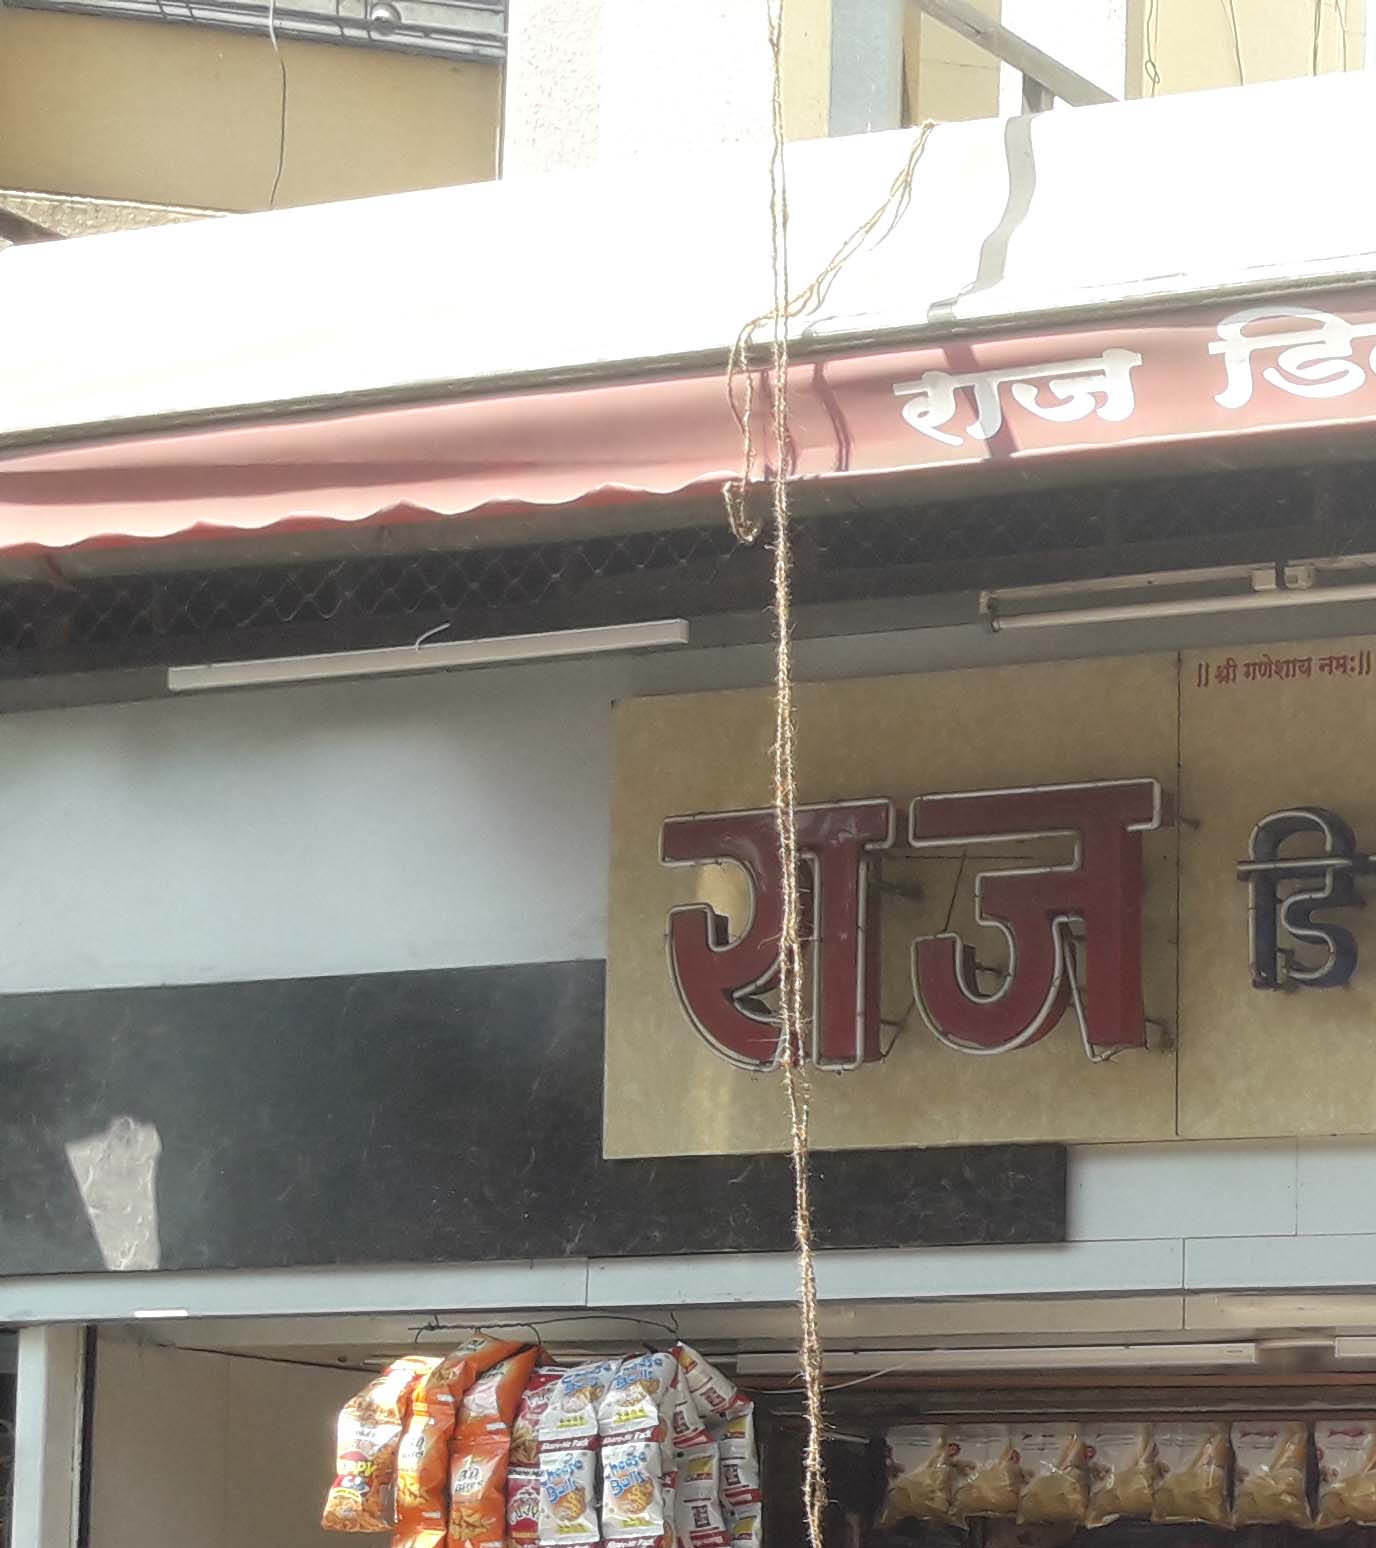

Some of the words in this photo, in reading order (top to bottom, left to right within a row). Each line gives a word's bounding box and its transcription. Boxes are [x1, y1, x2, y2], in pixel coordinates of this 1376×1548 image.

[893, 347, 1143, 447] राज
[1243, 654, 1313, 681] गणेशाय
[660, 778, 1163, 1073] राज
